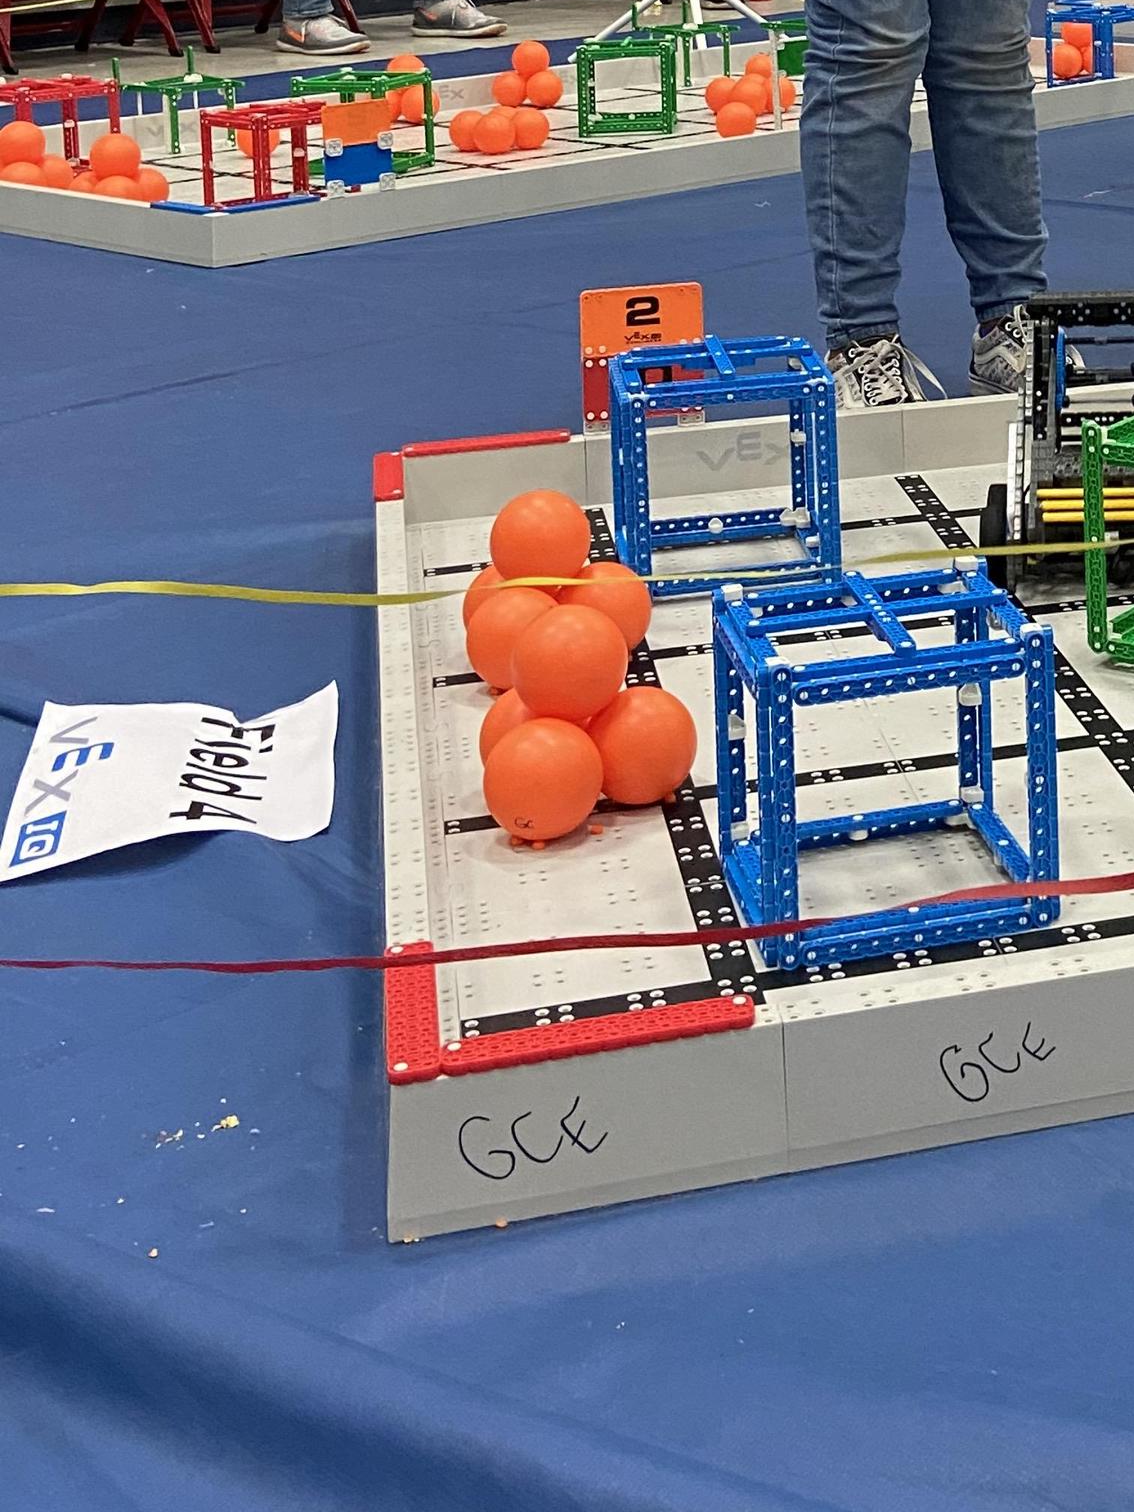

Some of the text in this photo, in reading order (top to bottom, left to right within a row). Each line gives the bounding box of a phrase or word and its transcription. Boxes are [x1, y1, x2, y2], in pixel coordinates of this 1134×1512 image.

[625, 296, 661, 327] 2
[24, 716, 114, 817] VEX
[169, 799, 257, 825] 4
[939, 1022, 1056, 1103] GCE
[458, 1096, 608, 1180] GCE
